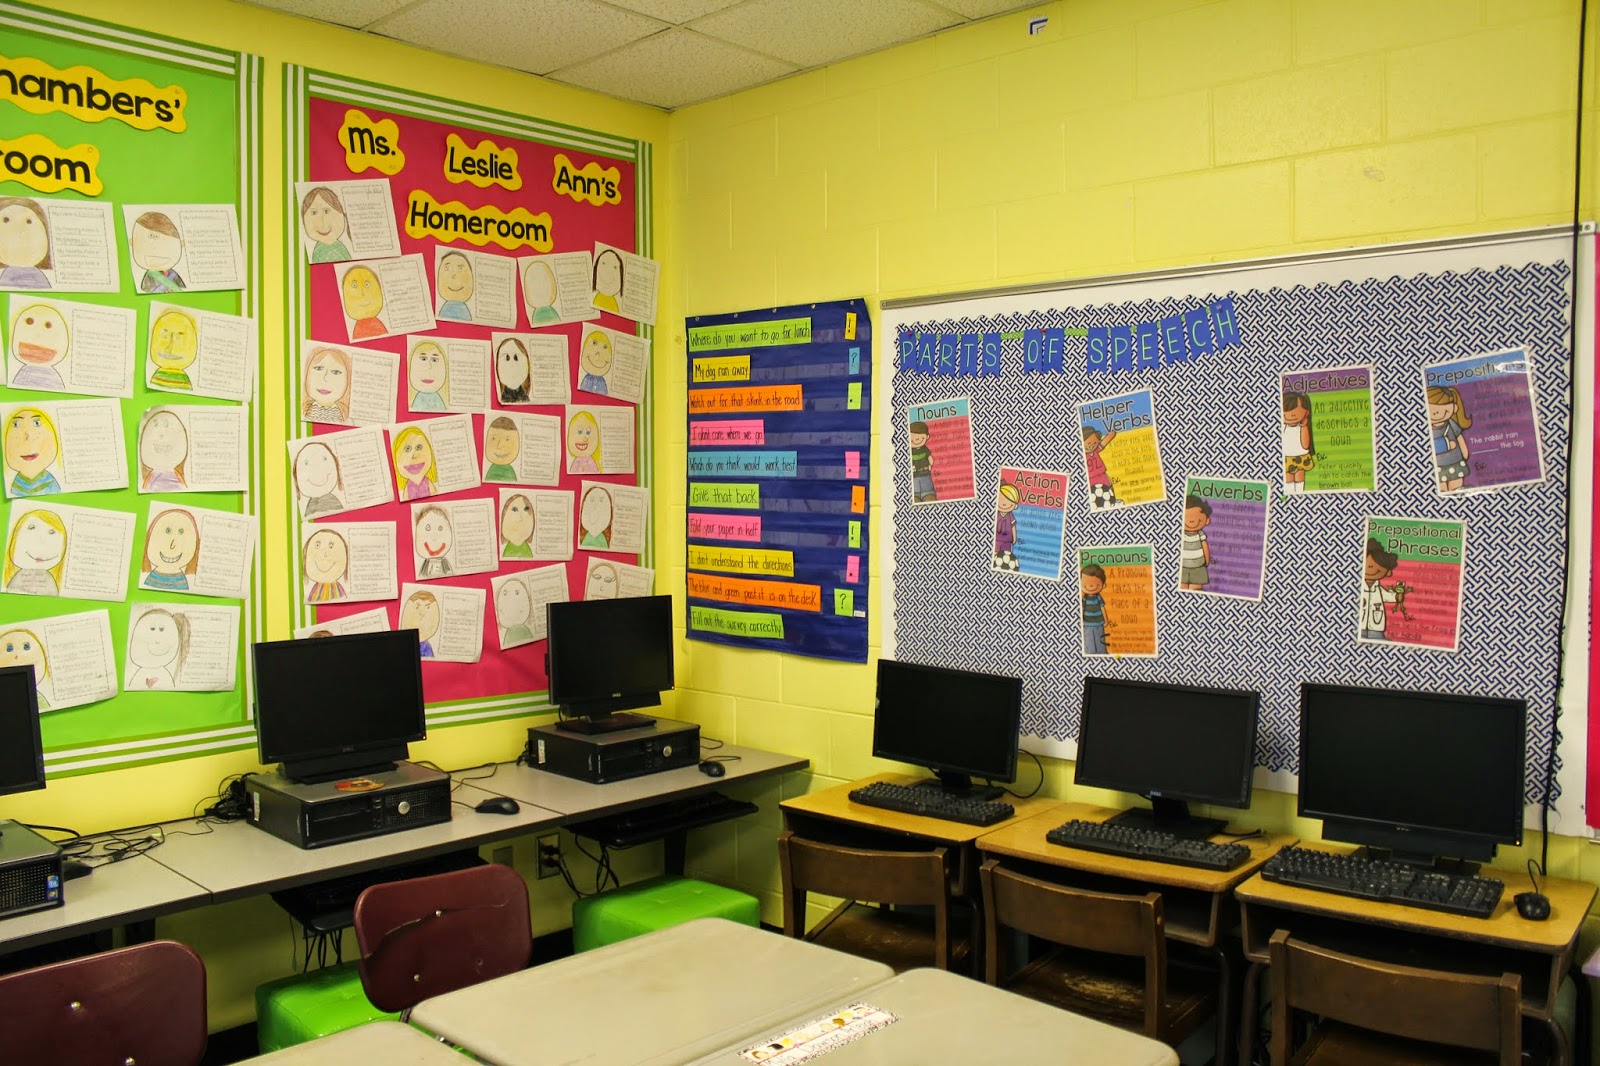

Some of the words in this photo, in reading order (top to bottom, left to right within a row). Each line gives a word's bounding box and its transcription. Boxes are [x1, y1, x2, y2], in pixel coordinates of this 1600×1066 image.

[0, 151, 91, 183] oom
[348, 127, 396, 156] Ms.
[449, 147, 513, 180] Leslie
[556, 166, 616, 198] Ann's
[410, 201, 547, 242] Homeroom
[691, 333, 711, 346] Where
[713, 331, 721, 344] do
[725, 334, 735, 347] you
[741, 329, 757, 342] want
[762, 330, 768, 340] to
[771, 332, 779, 344] go
[783, 325, 791, 339] for
[903, 341, 997, 367] PARTS
[1028, 338, 1059, 363] OF
[1090, 312, 1234, 364] SPEECH
[695, 364, 704, 380] My
[706, 365, 715, 380] dog
[718, 367, 729, 376] ran
[732, 366, 748, 378] away
[1283, 373, 1367, 394] Adjectives
[691, 395, 704, 408] Watch
[720, 394, 728, 407] for
[732, 393, 743, 406] that
[772, 391, 782, 405] the
[785, 390, 799, 405] road
[1314, 402, 1324, 414] An
[1082, 400, 1133, 421] Helper
[1102, 413, 1151, 432] Verbs
[1363, 417, 1368, 427] a
[712, 430, 724, 440] care
[727, 427, 740, 439] where
[744, 431, 751, 440] we
[755, 431, 762, 444] go
[706, 457, 713, 471] do
[726, 456, 740, 470] think
[744, 456, 760, 470] would
[766, 456, 779, 471] work
[782, 457, 795, 471] best
[1014, 471, 1060, 491] Action
[692, 487, 709, 503] Give
[713, 488, 732, 503] that
[736, 488, 757, 504] back
[1019, 489, 1063, 508] Verbs
[1190, 481, 1263, 501] Adverbs
[690, 518, 701, 533] Fold
[704, 523, 715, 536] your
[718, 523, 734, 538] paper
[746, 523, 758, 535] half
[1368, 521, 1461, 539] Prepositional
[1388, 538, 1459, 557] Phrases
[711, 553, 744, 568] understand
[747, 555, 758, 568] the
[763, 555, 792, 571] directions
[1080, 551, 1148, 564] Pronouns
[713, 583, 722, 595] and
[725, 587, 739, 599] green
[769, 592, 775, 601] is
[788, 589, 799, 603] the
[801, 590, 816, 605] desk
[693, 611, 703, 625] Fill
[704, 614, 712, 626] out
[714, 613, 723, 628] the
[727, 620, 746, 634] survey
[750, 620, 781, 637] correctly
